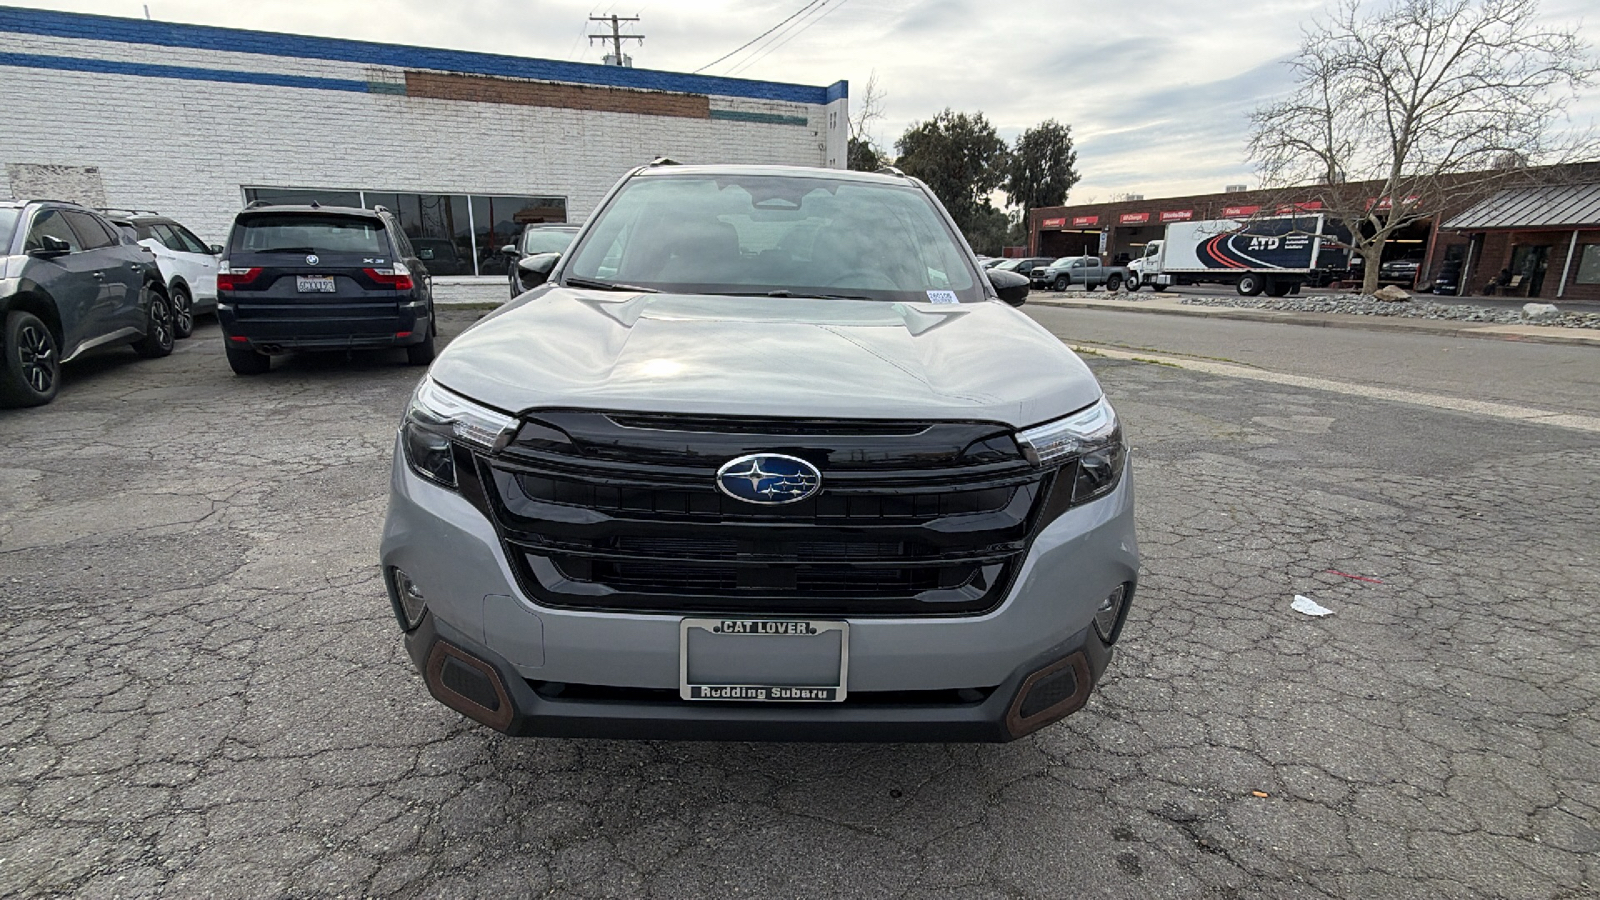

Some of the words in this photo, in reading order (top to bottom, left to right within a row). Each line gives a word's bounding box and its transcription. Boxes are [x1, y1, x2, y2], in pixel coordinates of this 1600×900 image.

[1248, 237, 1280, 250] ATD
[723, 622, 753, 633] CAT
[757, 622, 807, 634] LOVER
[700, 687, 766, 699] Redding
[771, 688, 828, 699] Subaru
